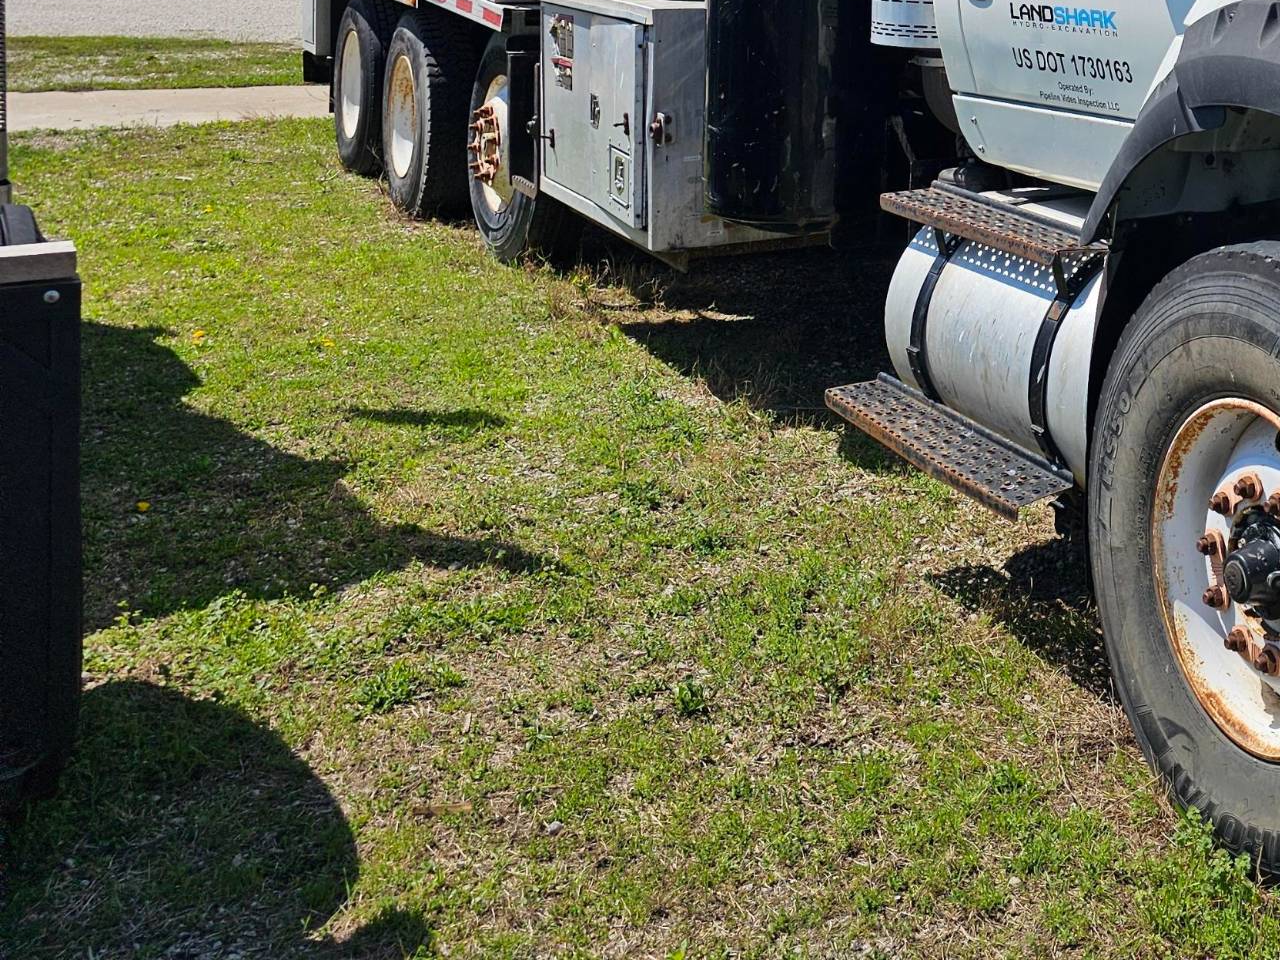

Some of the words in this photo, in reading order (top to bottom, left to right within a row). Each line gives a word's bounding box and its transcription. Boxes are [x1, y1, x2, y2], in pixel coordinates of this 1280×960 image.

[1009, 2, 1118, 30] LANDSHARK
[1012, 21, 1118, 37] HYDRO-EXCAVATION
[1012, 47, 1033, 70] US
[1035, 50, 1066, 74] DOT
[1071, 54, 1133, 83] 1730163
[1058, 82, 1083, 93] Operated
[1039, 90, 1061, 102] Pipeline
[1060, 93, 1078, 105] Video
[1077, 96, 1107, 109] Inspection
